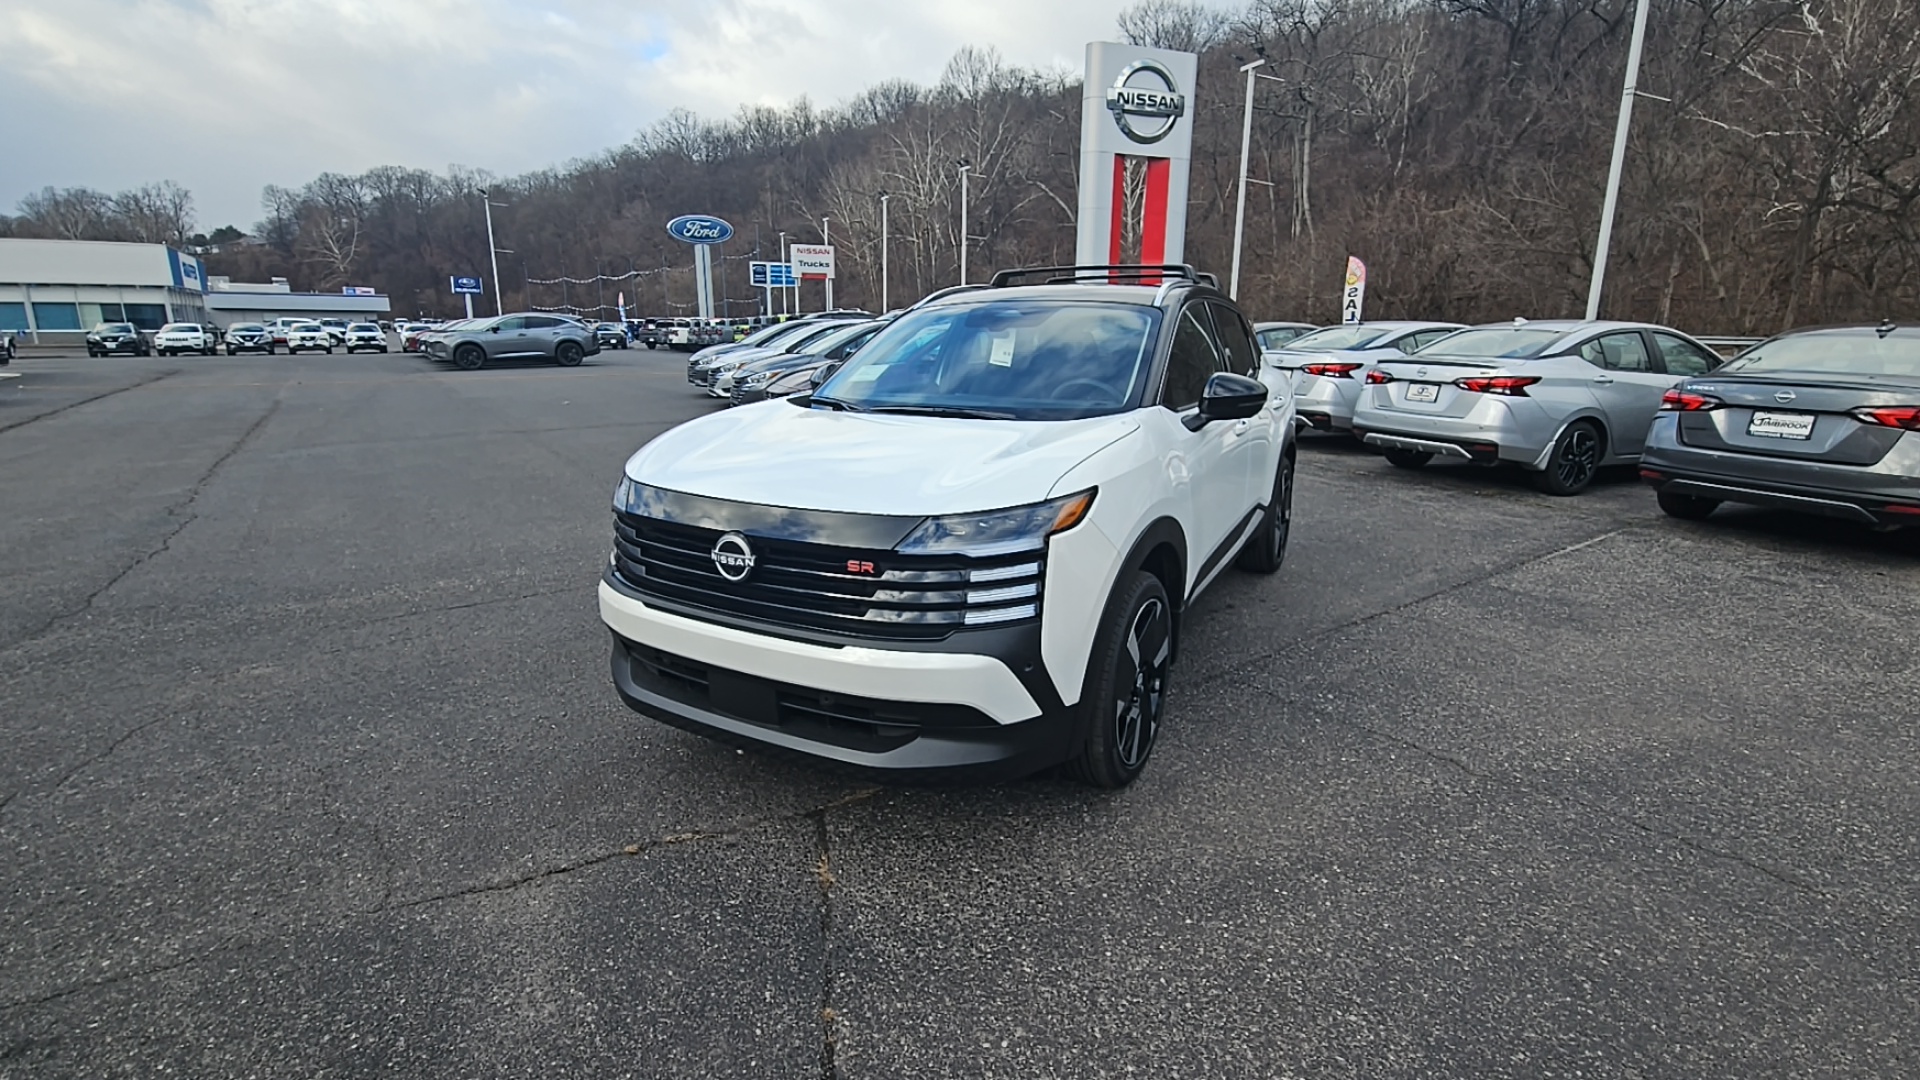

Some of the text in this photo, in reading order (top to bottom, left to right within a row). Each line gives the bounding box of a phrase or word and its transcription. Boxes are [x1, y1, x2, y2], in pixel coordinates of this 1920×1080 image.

[1116, 92, 1179, 110] NISSAN
[683, 220, 720, 238] Ford
[796, 247, 831, 255] NISSAN
[798, 260, 830, 268] Trucks
[711, 551, 756, 567] NISSAN
[846, 559, 875, 574] SR
